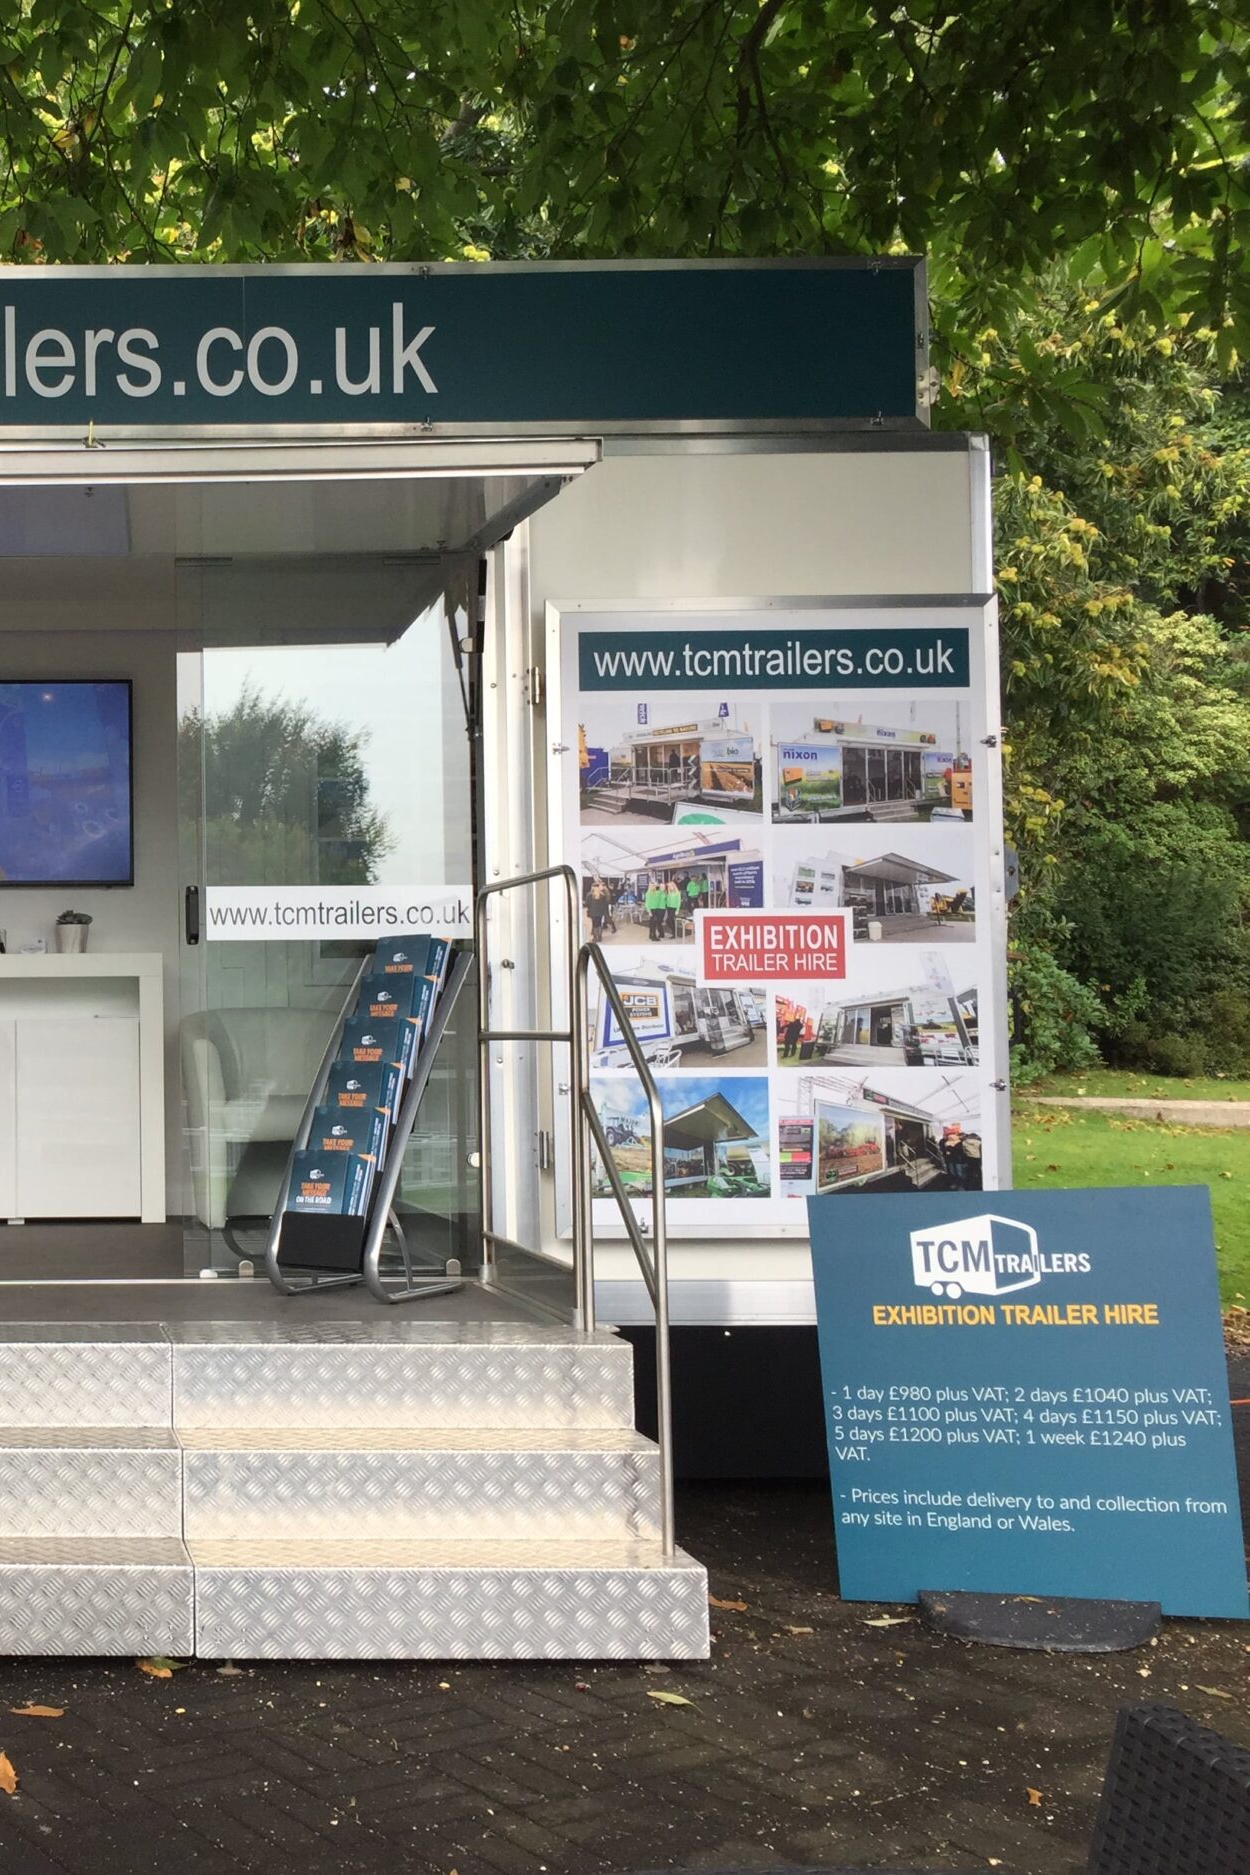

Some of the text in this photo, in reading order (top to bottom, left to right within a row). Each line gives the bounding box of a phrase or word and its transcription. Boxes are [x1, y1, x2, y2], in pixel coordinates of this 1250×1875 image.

[593, 640, 955, 677] www.tcmtrailers.co.uk
[783, 750, 818, 761] nixon
[210, 900, 471, 926] www.tcmtrailers.co.uk
[710, 925, 838, 951] EXHIBITION
[711, 953, 837, 972] TRAILER HIRE
[623, 995, 657, 1006] JCB
[916, 1240, 1091, 1273] TCM TRAILERS
[873, 1304, 1159, 1325] EXHIBITION TRAILER HIRE
[842, 1386, 852, 1399] 1
[857, 1386, 884, 1402] day
[889, 1386, 931, 1401] £980
[936, 1387, 969, 1403] plus
[972, 1387, 1009, 1403] VAT;
[1014, 1388, 1025, 1402] 2
[1031, 1388, 1068, 1405] days
[1073, 1388, 1129, 1403] £1040
[1134, 1389, 1169, 1406] plus
[1172, 1389, 1212, 1405] VAT;
[833, 1406, 1222, 1427] 3 days £1100 plus VAT; 4 days £1150 plus VAT;
[834, 1426, 1187, 1449] 5 days £1200 plus VAT; 1 week £1240 plus
[835, 1446, 871, 1461] VAT.
[851, 1488, 899, 1504] Prices
[904, 1490, 962, 1506] include
[967, 1492, 1032, 1511] delivery
[1037, 1495, 1054, 1509] to
[1060, 1495, 1091, 1510] and
[1097, 1496, 1180, 1513] collection
[1185, 1497, 1228, 1514] from
[841, 1511, 1075, 1531] any site in England or Wales.
